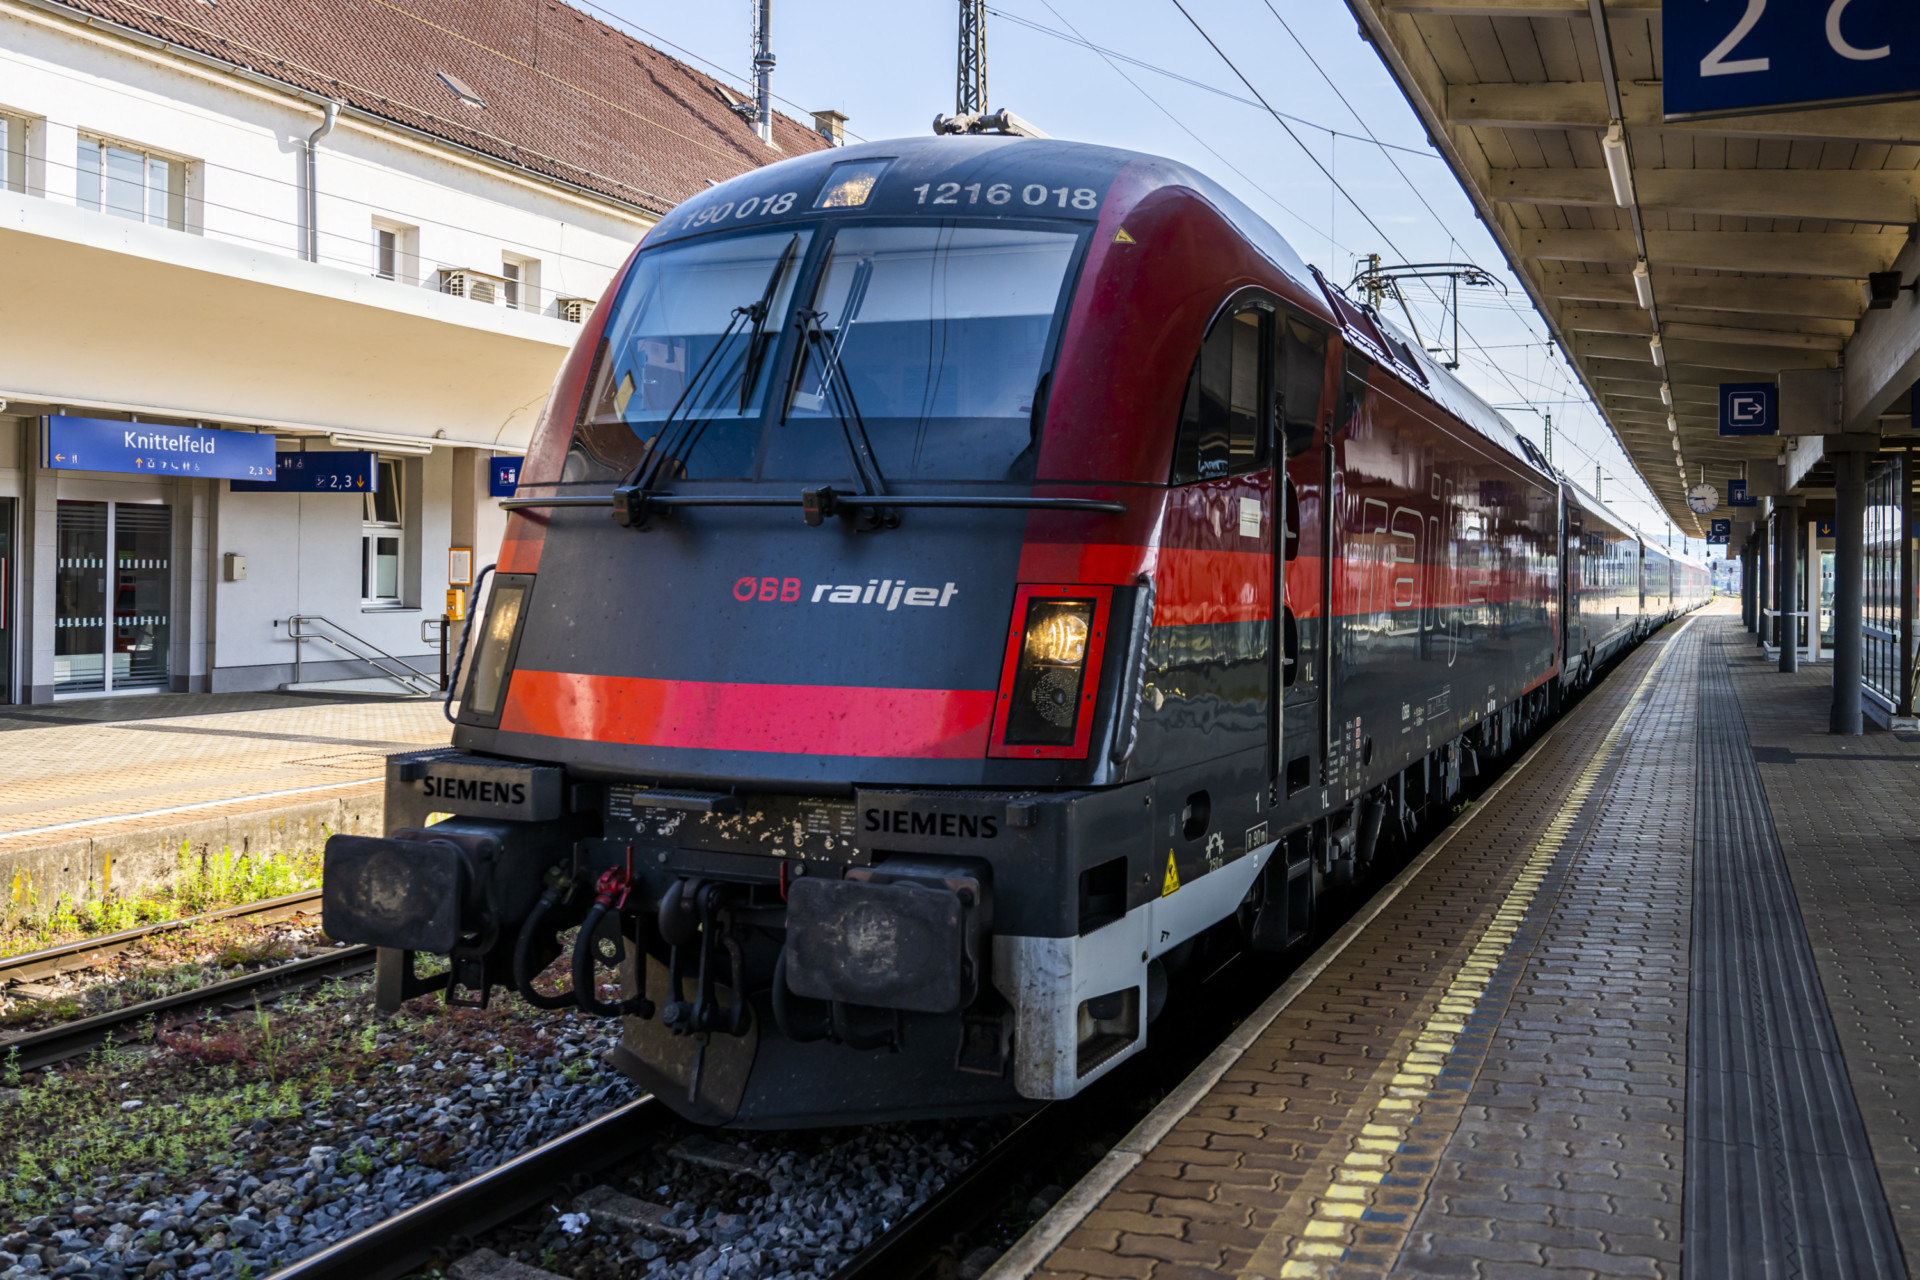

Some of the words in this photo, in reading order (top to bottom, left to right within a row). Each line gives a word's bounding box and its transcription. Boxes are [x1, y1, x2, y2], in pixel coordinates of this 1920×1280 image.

[1700, 0, 1769, 77] 2
[914, 182, 1012, 205] 1216
[1022, 184, 1097, 210] 018
[682, 202, 735, 230] 190
[735, 192, 797, 219] 018
[124, 431, 215, 454] Knittelfeld
[330, 475, 352, 489] 2,3
[733, 576, 801, 602] ÖBB
[811, 579, 959, 611] railjet
[1305, 662, 1314, 681] 1L
[423, 775, 525, 804] SIEMENS
[1255, 792, 1260, 813] 1
[1321, 789, 1330, 809] 1L
[865, 808, 998, 839] SIEMENS
